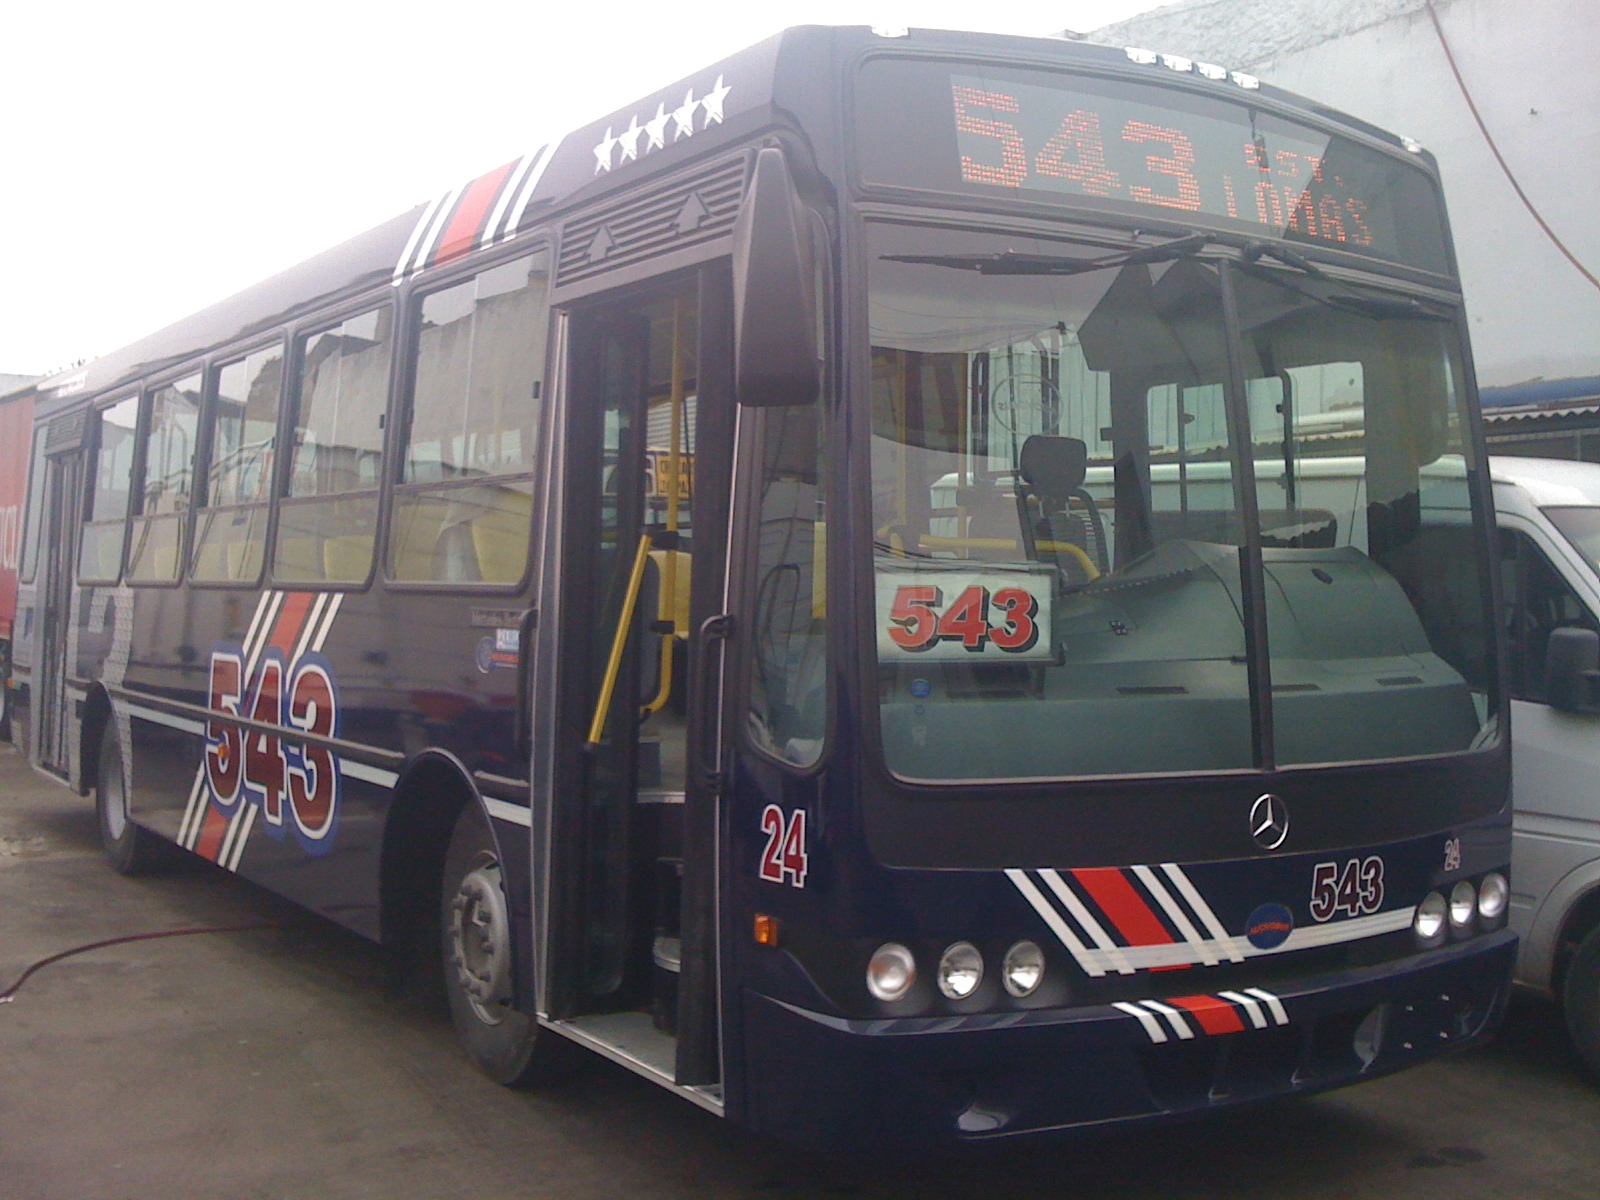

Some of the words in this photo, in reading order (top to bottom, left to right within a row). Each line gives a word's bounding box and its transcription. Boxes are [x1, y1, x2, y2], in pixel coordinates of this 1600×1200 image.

[953, 84, 1201, 212] 543
[886, 584, 1039, 653] 543
[204, 652, 337, 840] 543
[759, 803, 808, 888] 24
[1444, 837, 1461, 872] 24
[1310, 855, 1385, 922] 543
